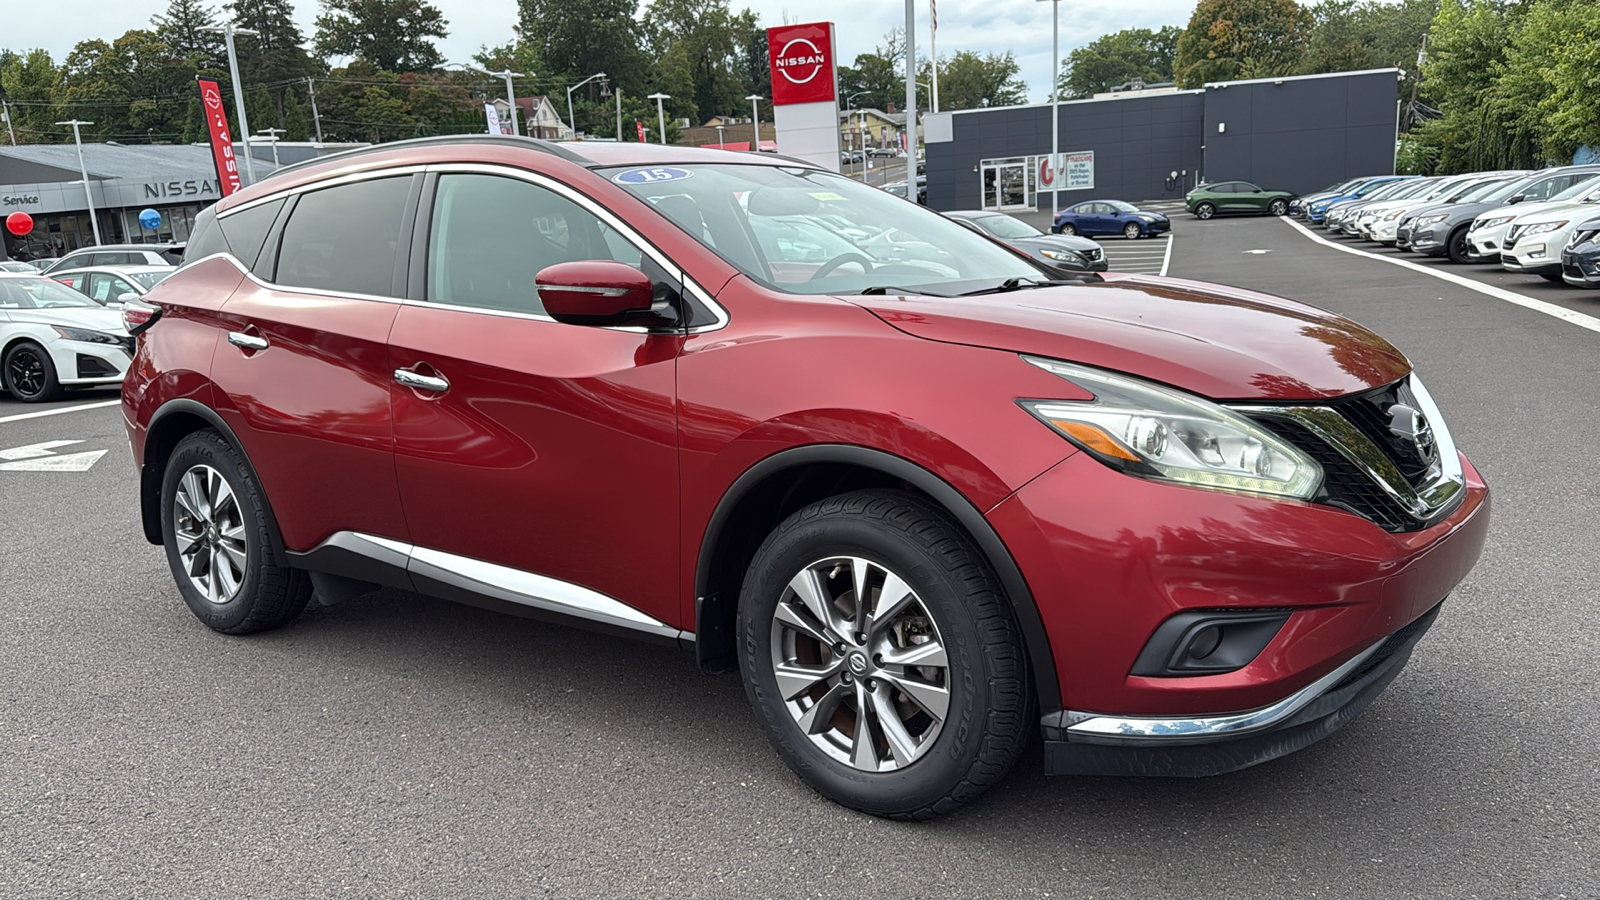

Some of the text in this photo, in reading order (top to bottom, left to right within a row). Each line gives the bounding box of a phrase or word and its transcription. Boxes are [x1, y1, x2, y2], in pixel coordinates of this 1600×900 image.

[776, 55, 825, 67] NISSAN
[637, 169, 672, 181] 15
[3, 195, 39, 206] Service
